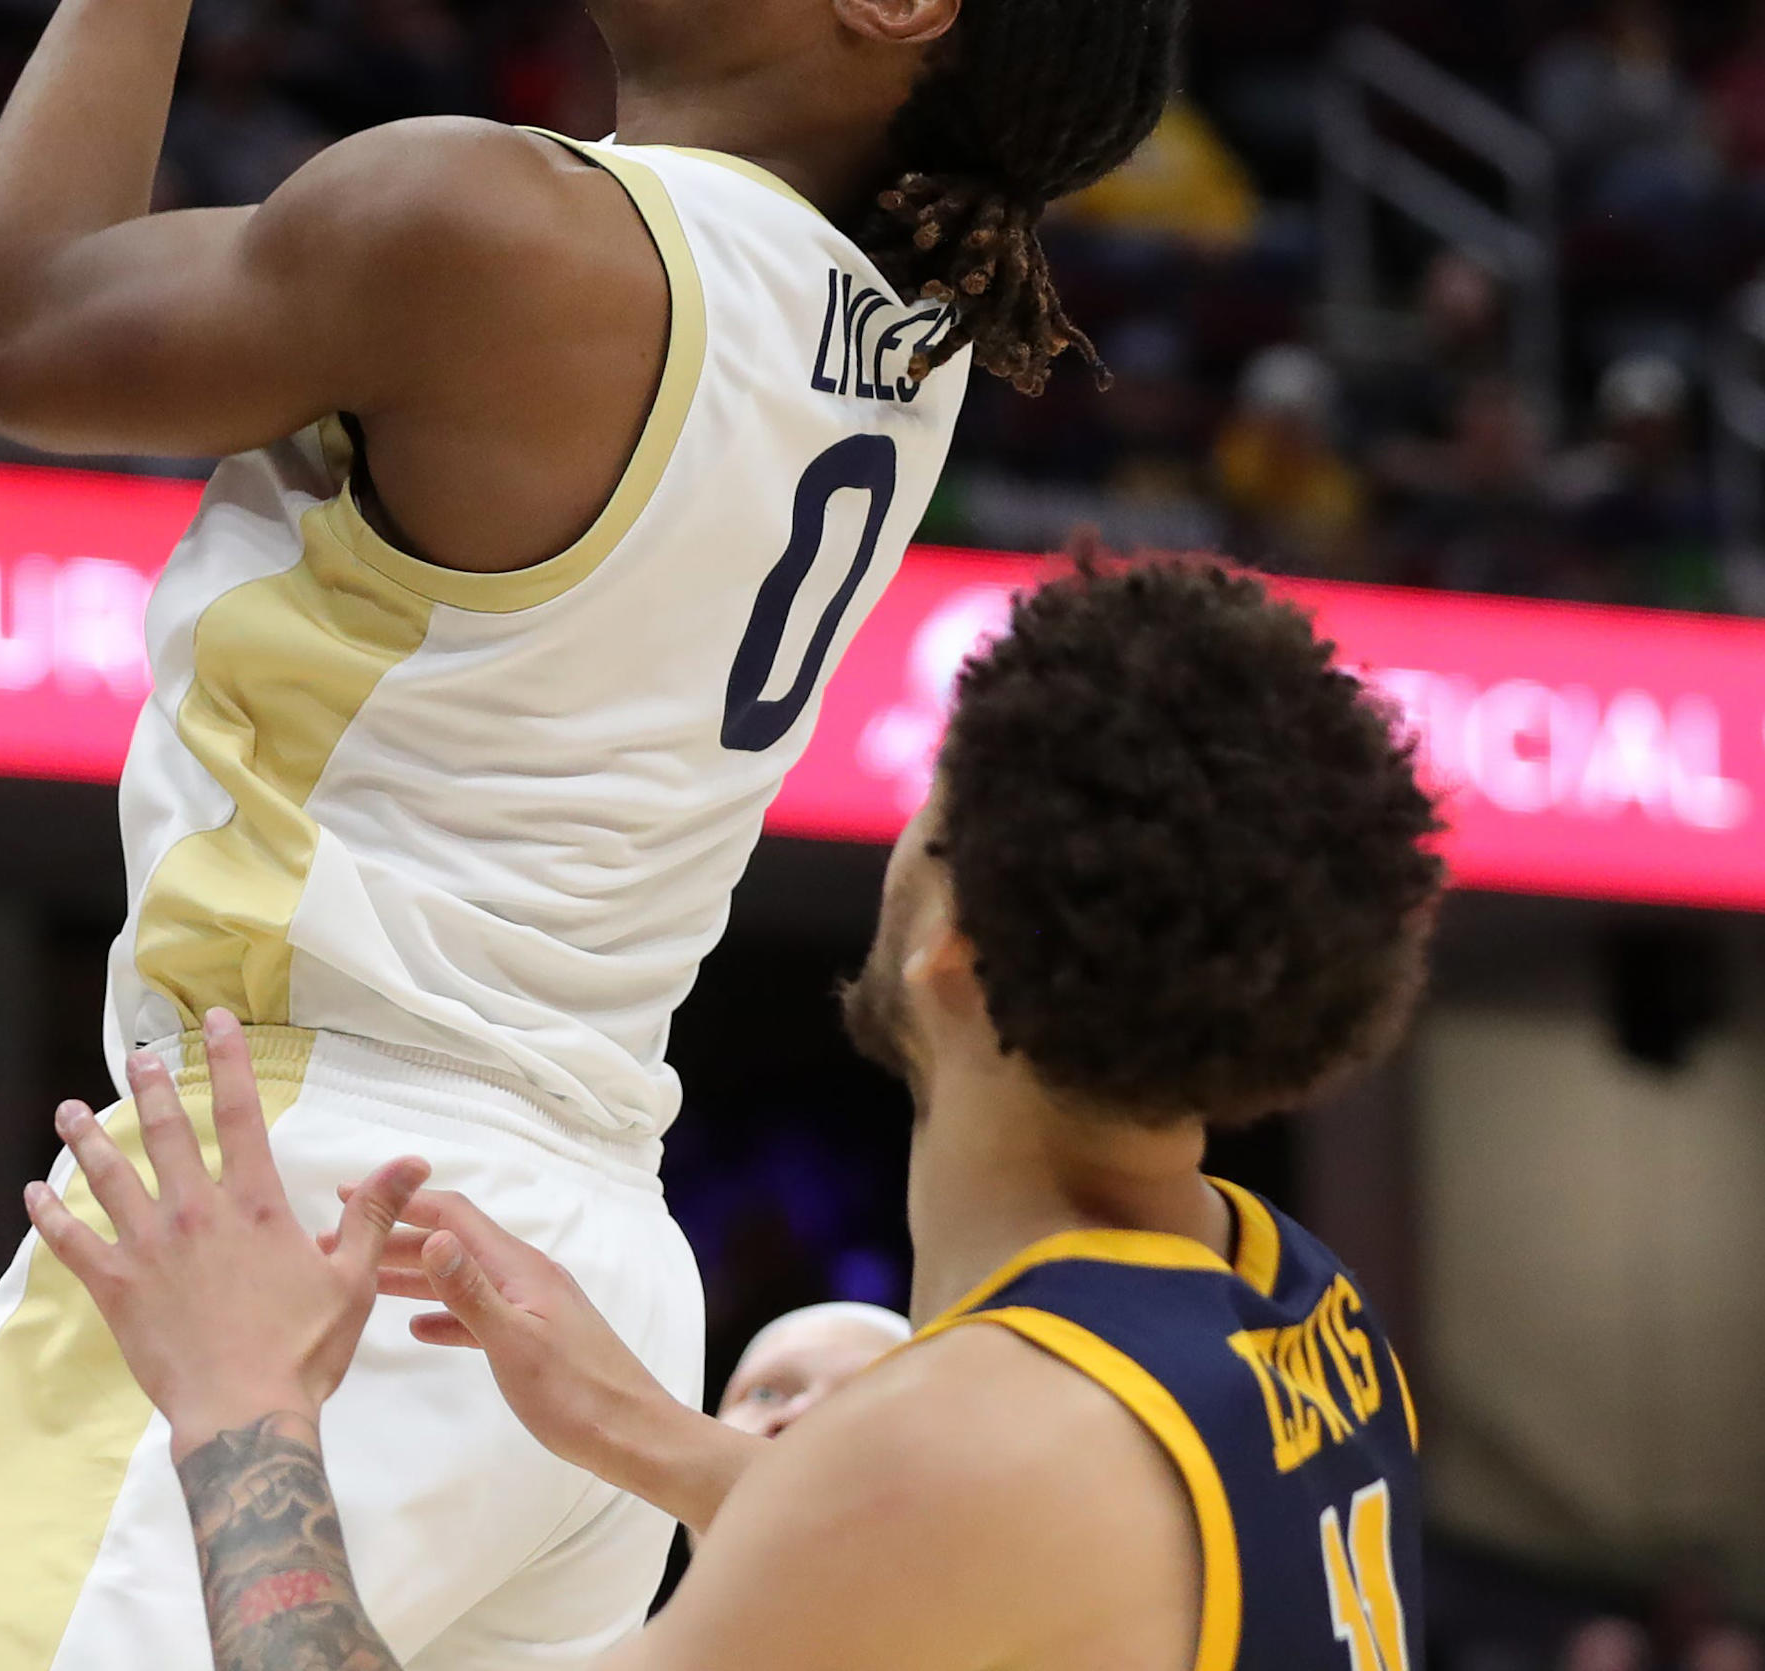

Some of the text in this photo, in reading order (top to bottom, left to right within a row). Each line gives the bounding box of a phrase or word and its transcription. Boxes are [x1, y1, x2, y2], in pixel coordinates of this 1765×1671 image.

[811, 268, 956, 402] LYLES
[721, 433, 896, 751] 0
[1339, 666, 1754, 831] ICIAL
